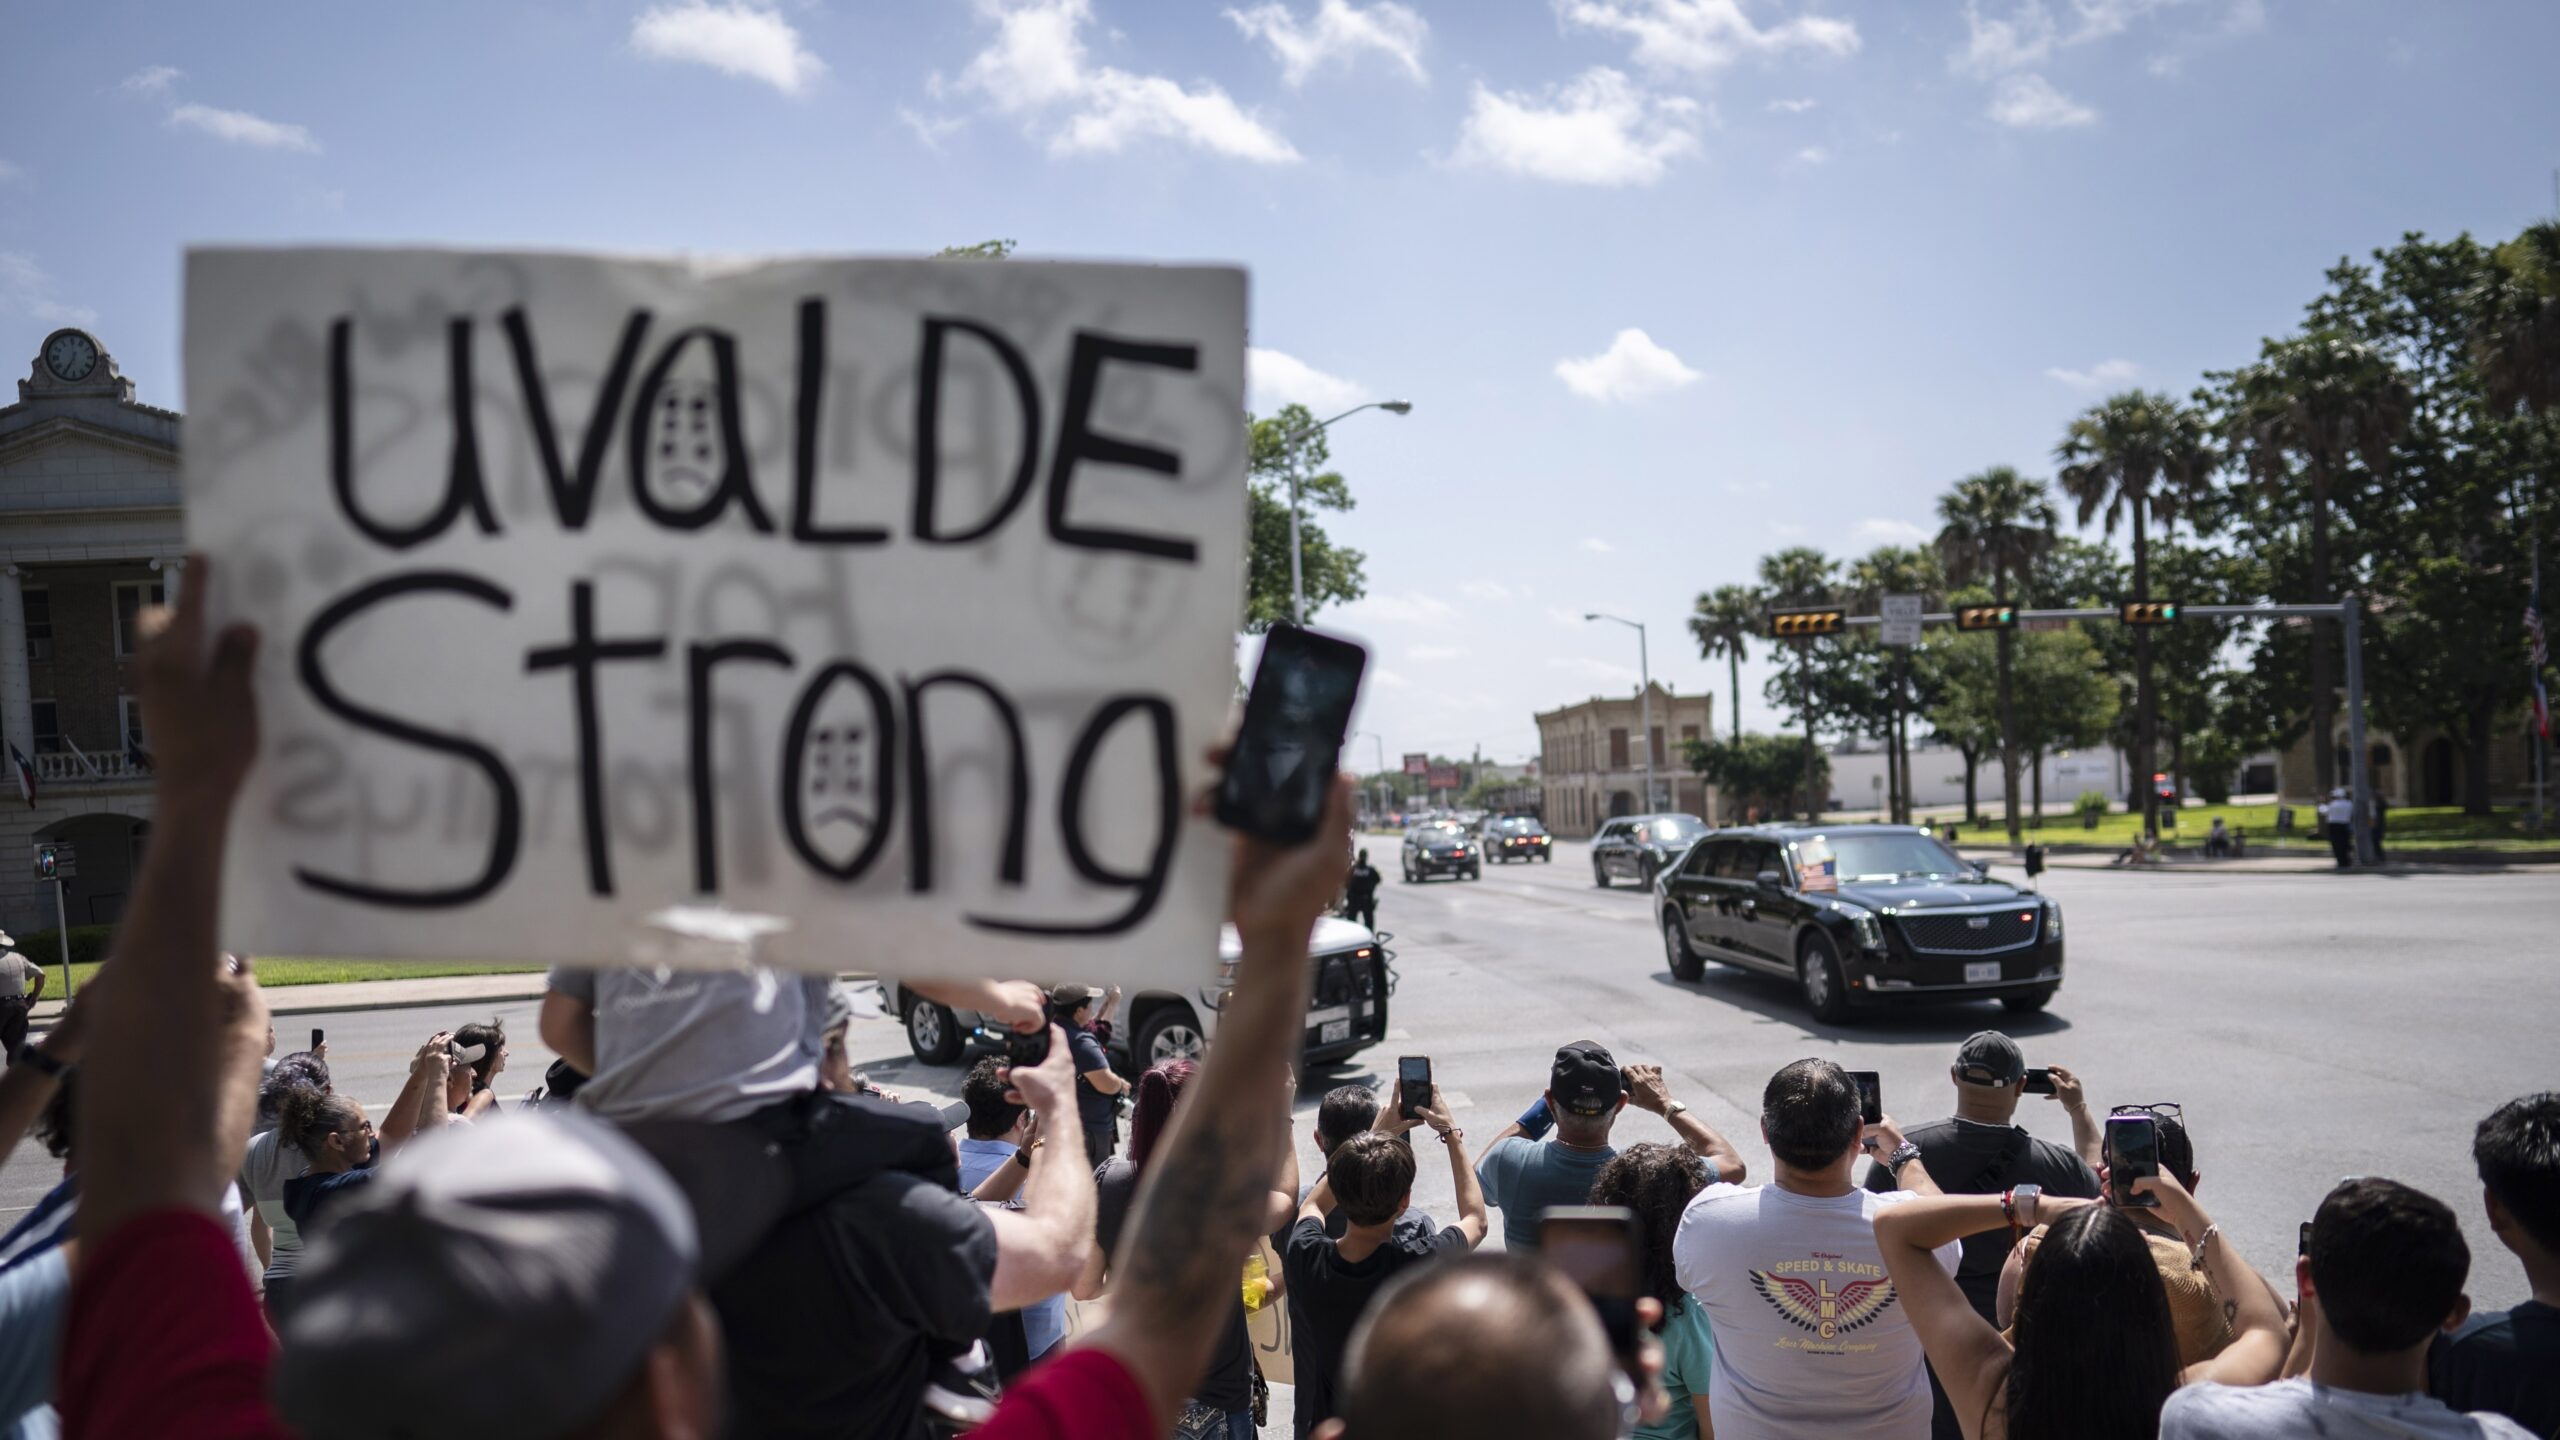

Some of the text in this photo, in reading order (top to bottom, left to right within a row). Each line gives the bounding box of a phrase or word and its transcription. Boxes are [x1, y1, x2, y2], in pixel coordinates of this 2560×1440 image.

[294, 569, 1181, 938] Strong
[1775, 1260, 1881, 1277] SPEED & SKATE
[1819, 1279, 1836, 1339] LMC
